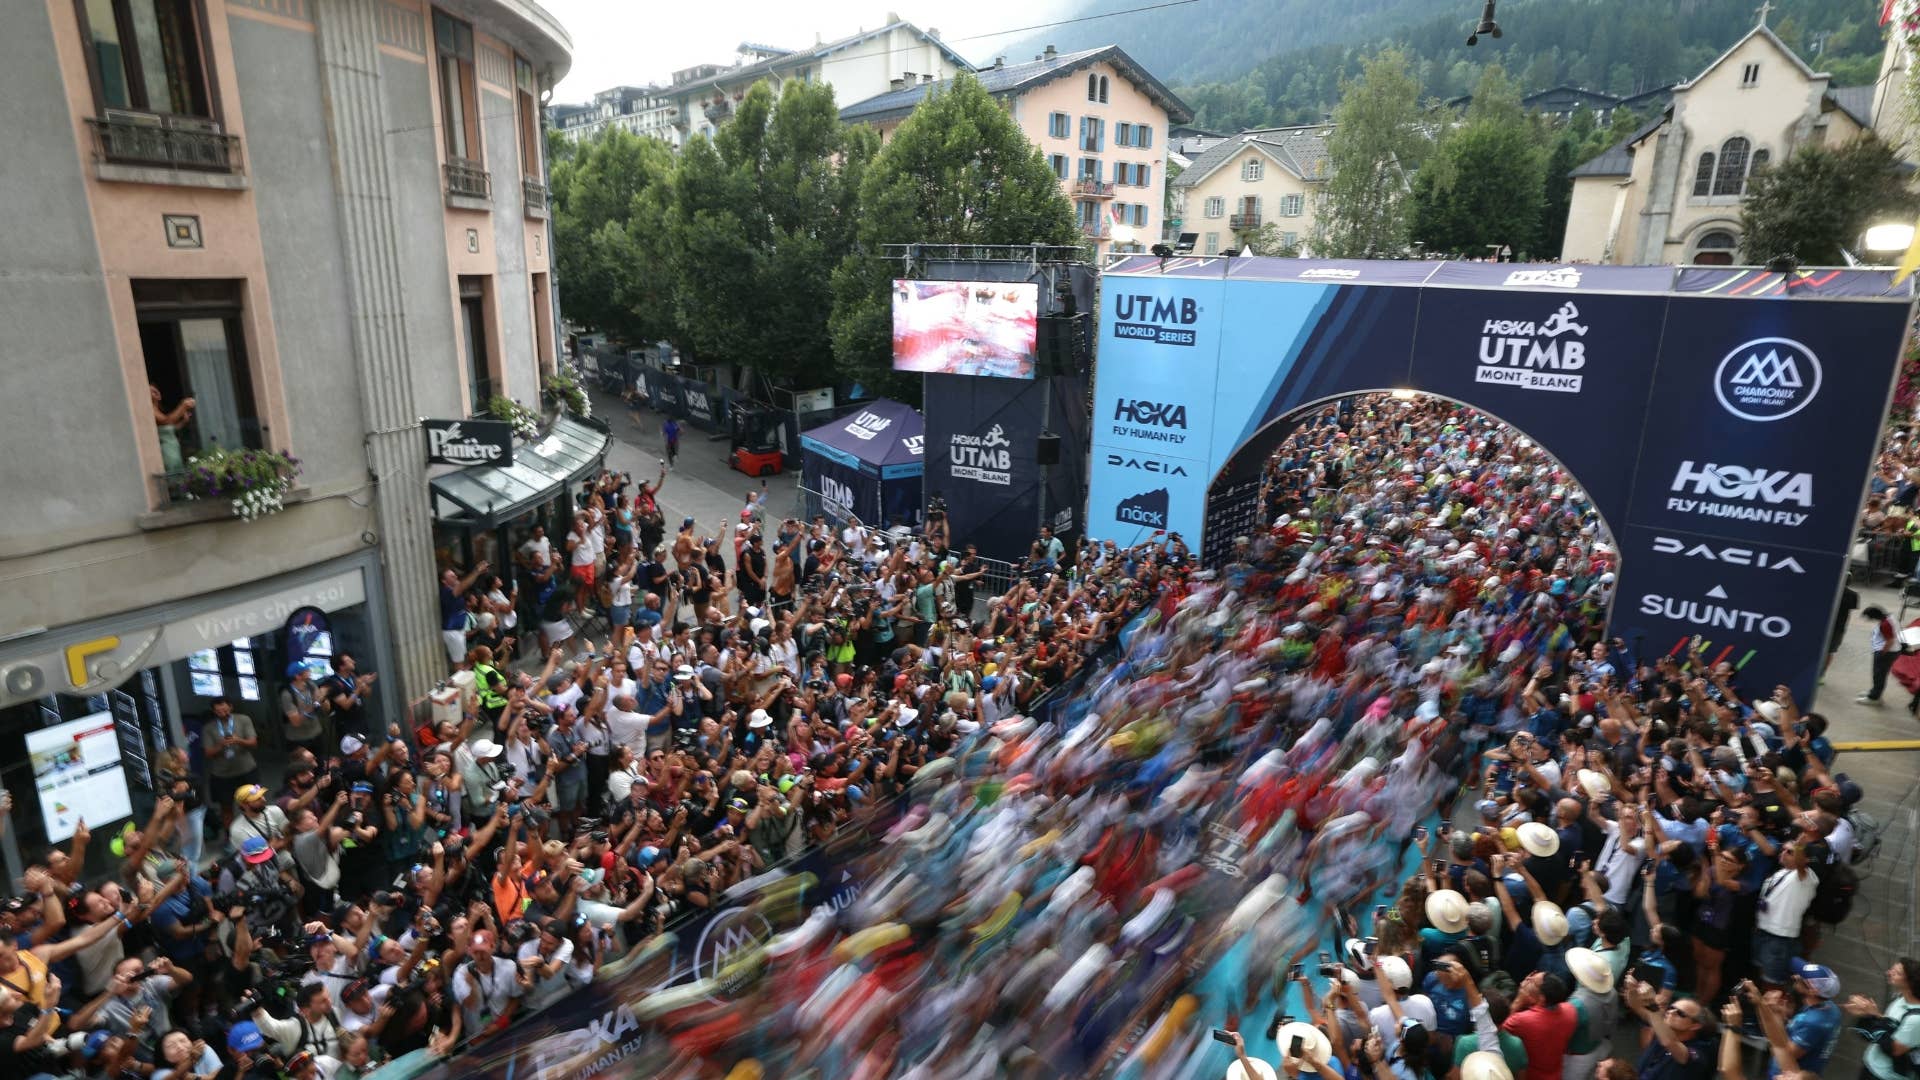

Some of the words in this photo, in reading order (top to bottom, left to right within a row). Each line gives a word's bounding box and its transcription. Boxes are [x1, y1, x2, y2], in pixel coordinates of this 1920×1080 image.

[1116, 294, 1197, 324] UTMB
[1118, 326, 1155, 337] WORLD
[1159, 332, 1192, 343] SERIES
[1483, 319, 1536, 336] HOKA
[1479, 337, 1586, 370] UTMB
[1734, 386, 1795, 399] CHAMONIX
[1115, 398, 1187, 429] HOKA
[951, 434, 981, 446] HOKA
[1113, 426, 1128, 435] FLY
[1130, 428, 1167, 442] HUMAN
[1169, 434, 1186, 443] FLY
[951, 446, 1011, 470] UTMB
[1108, 455, 1188, 477] DACIA
[821, 475, 853, 509] UTMB
[1671, 460, 1813, 507] HOKA
[1667, 498, 1698, 512] FLY
[1698, 502, 1772, 522] HUMAN
[1773, 511, 1808, 526] FLY
[1653, 536, 1806, 573] DACIA
[194, 612, 257, 640] Vivre
[316, 580, 344, 605] soi
[1639, 594, 1791, 638] SUUNTO
